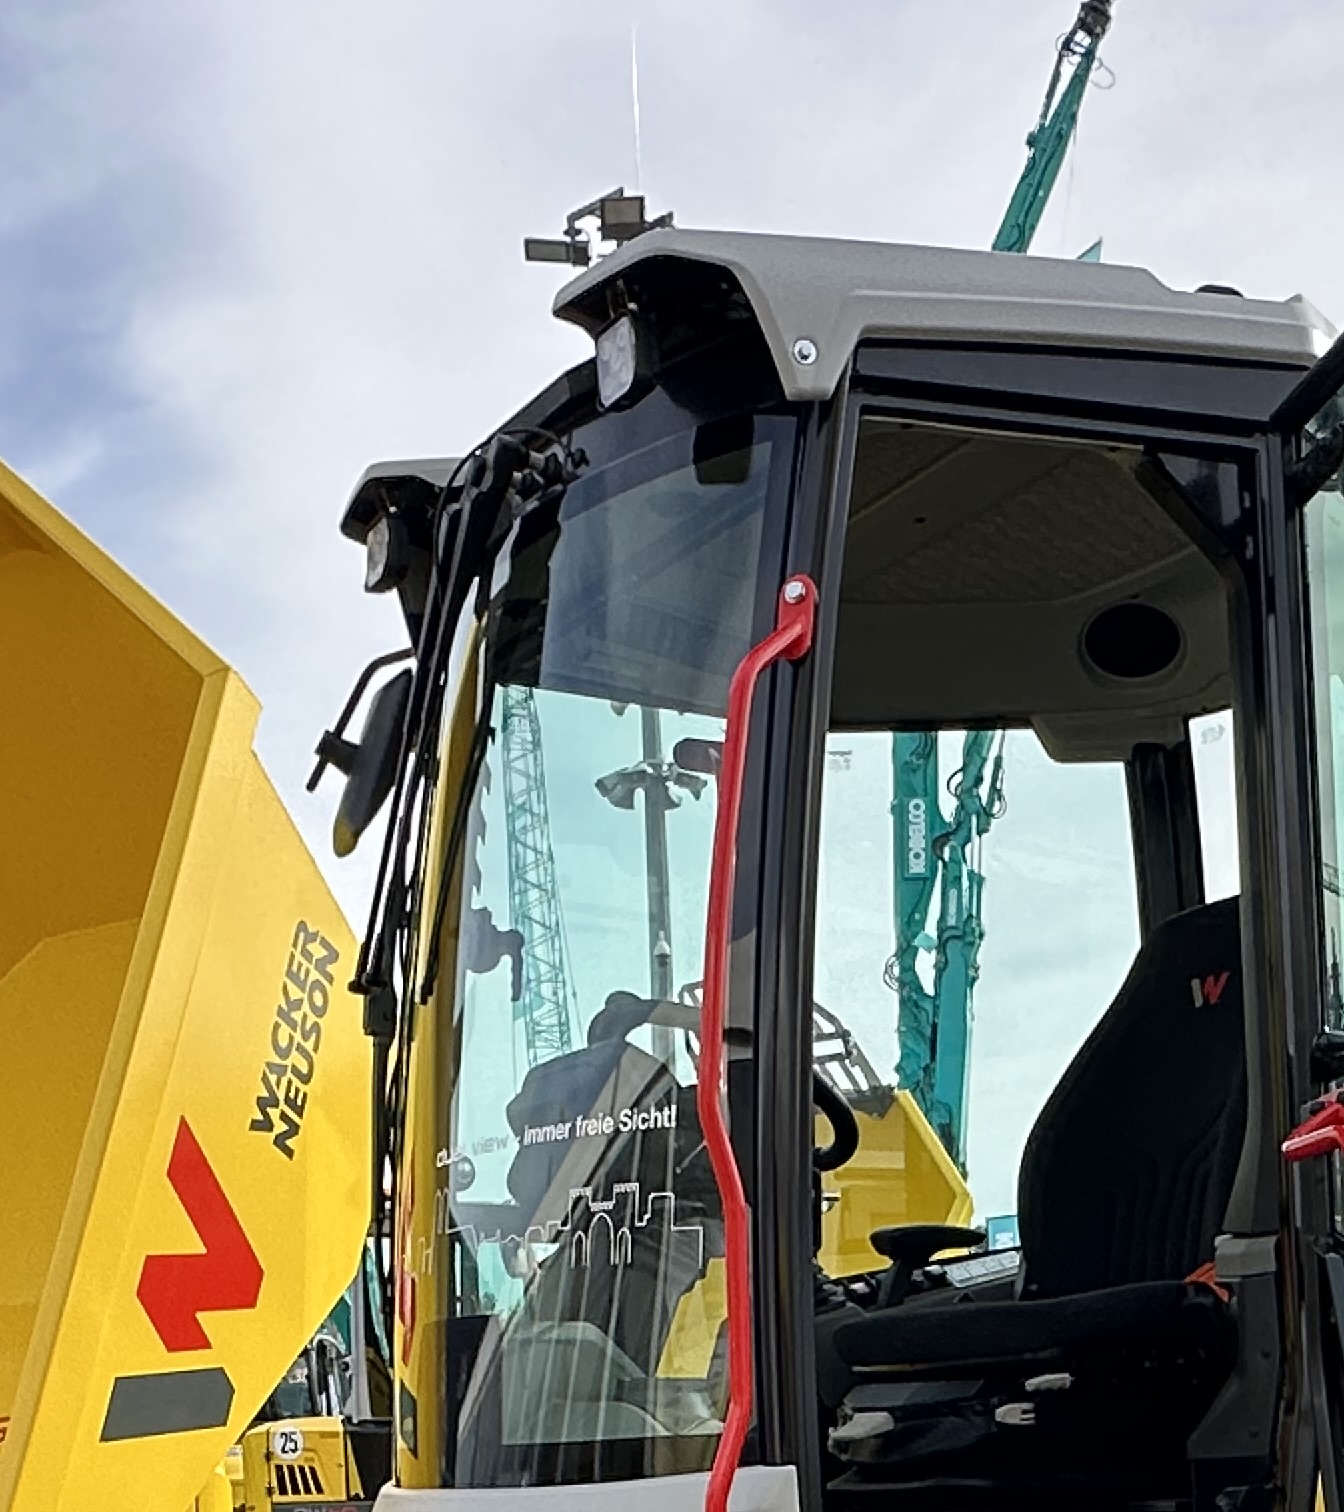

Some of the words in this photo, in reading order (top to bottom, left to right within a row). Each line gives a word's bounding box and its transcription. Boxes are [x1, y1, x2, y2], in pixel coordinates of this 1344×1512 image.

[249, 920, 319, 1133] WACKER
[272, 935, 342, 1160] NEUSON
[523, 1121, 572, 1146] immer
[576, 1115, 614, 1137] freie
[618, 1104, 677, 1133] Sicht!
[280, 1432, 299, 1454] 25
